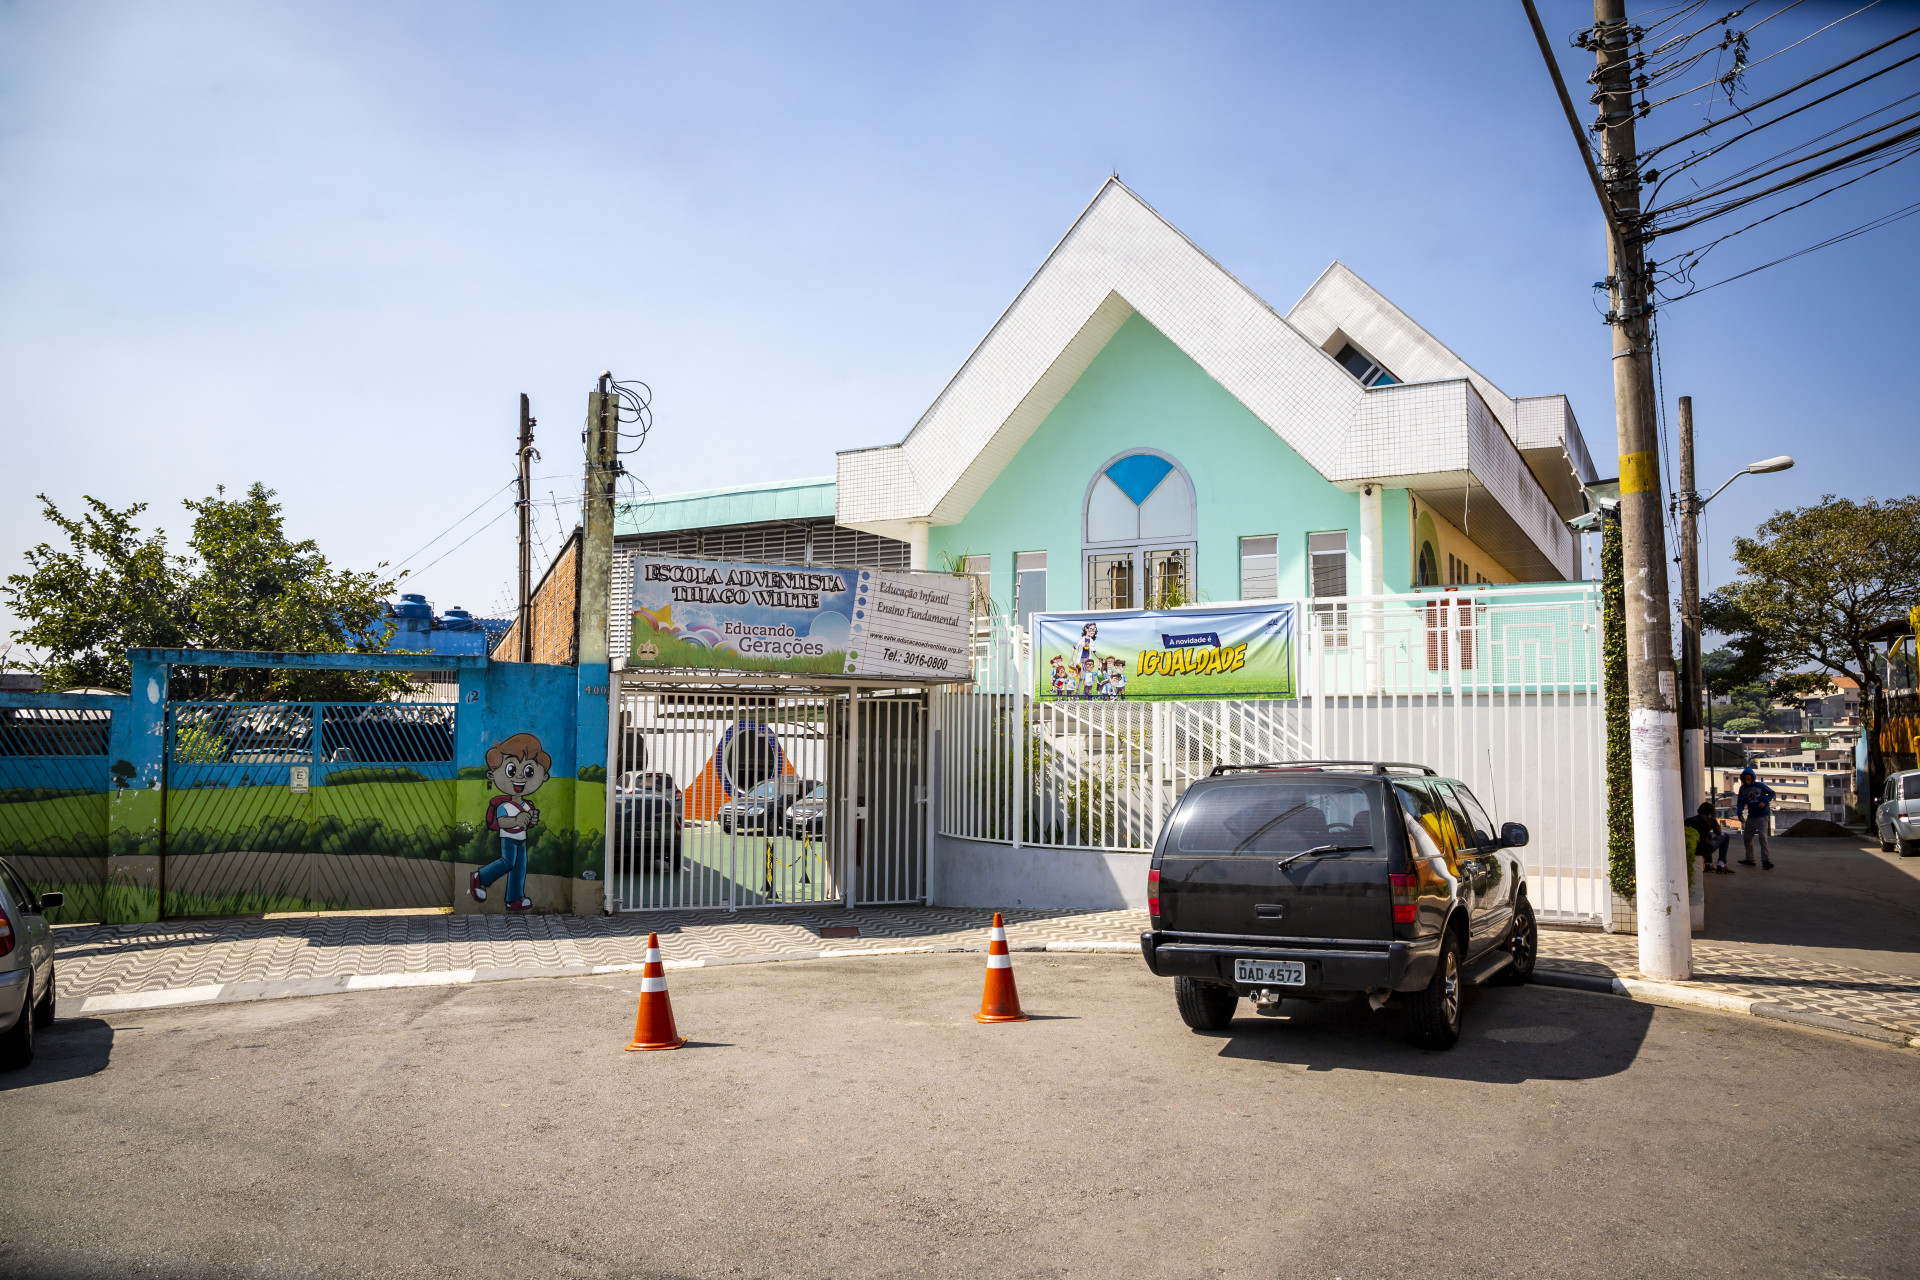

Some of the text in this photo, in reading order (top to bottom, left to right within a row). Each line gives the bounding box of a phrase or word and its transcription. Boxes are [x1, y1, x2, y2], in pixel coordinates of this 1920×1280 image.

[645, 563, 847, 593] ESCOLA ADVENTISTA
[672, 586, 820, 609] THIAGO WHITE
[879, 582, 950, 606] Educação Infantil
[877, 601, 960, 627] Ensino Fundamental
[724, 622, 795, 637] Educando
[1169, 635, 1212, 646] A novidade é
[738, 637, 824, 659] Gerações
[883, 648, 949, 670] Tel.: 3016-0800
[1137, 643, 1248, 677] IGUALDADE
[466, 690, 479, 703] 12
[584, 685, 609, 696] 400
[297, 771, 304, 780] E
